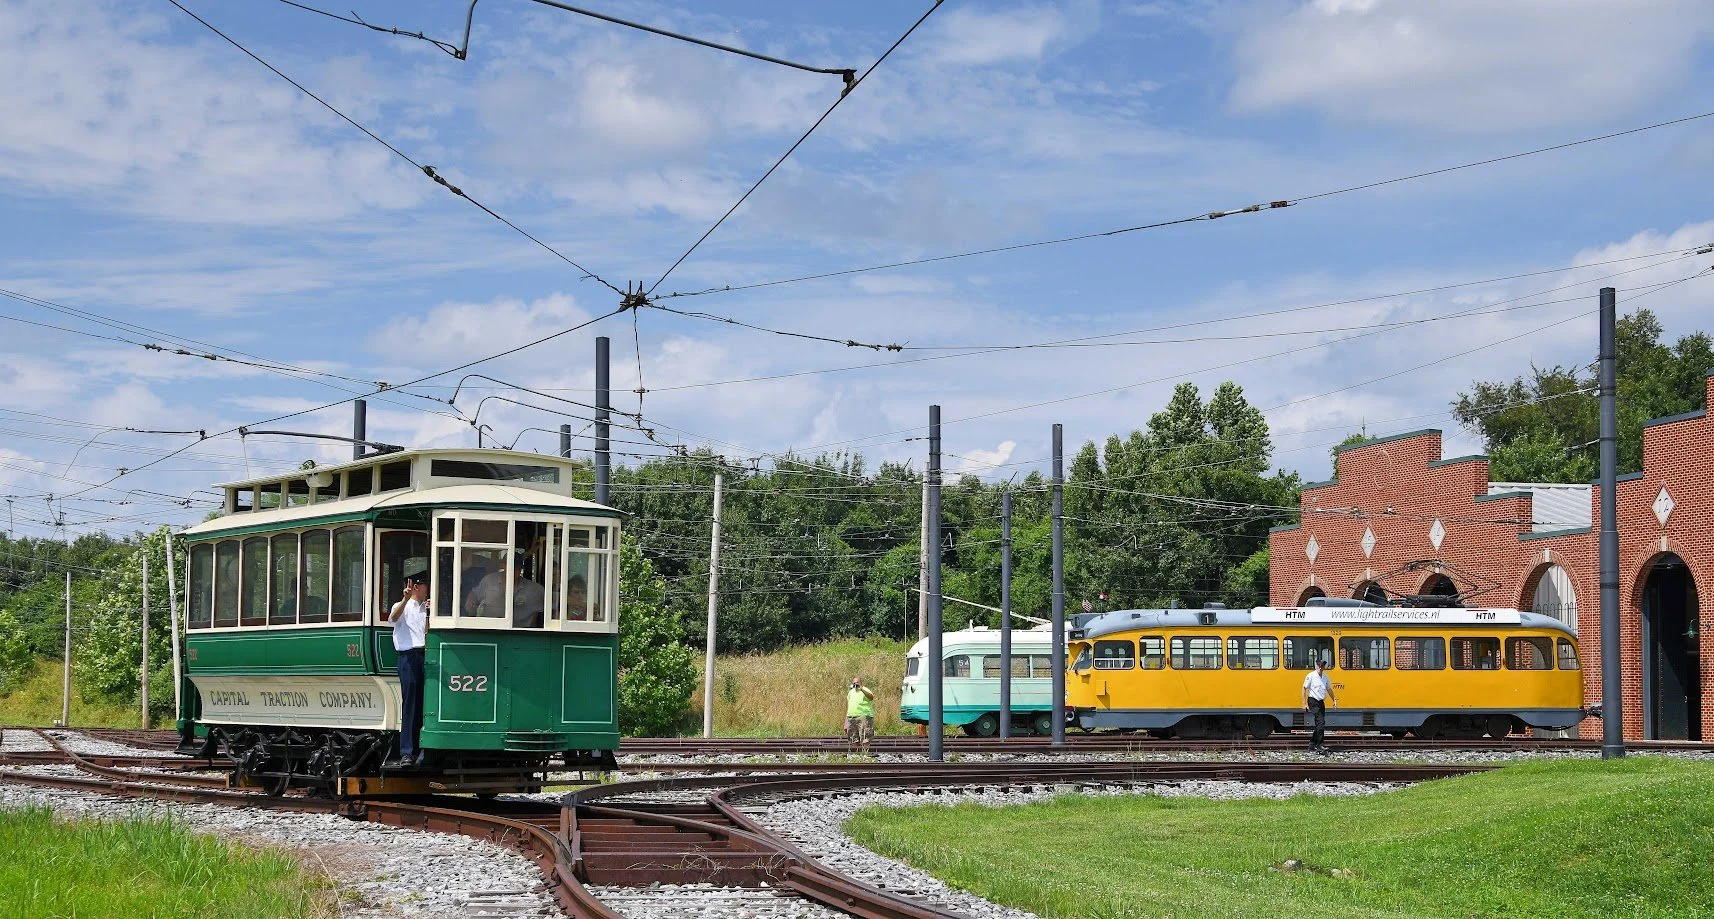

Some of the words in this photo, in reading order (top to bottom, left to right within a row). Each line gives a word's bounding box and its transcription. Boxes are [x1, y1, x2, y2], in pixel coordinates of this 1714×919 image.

[1285, 611, 1306, 619] HTM
[1331, 608, 1441, 621] www.lightrailservices.nl
[1475, 612, 1496, 620] HTM
[346, 643, 360, 657] 522
[448, 675, 488, 692] 522
[210, 690, 250, 706] CAPITAL
[260, 691, 309, 708] TRACTION
[319, 691, 376, 709] COMPANY.
